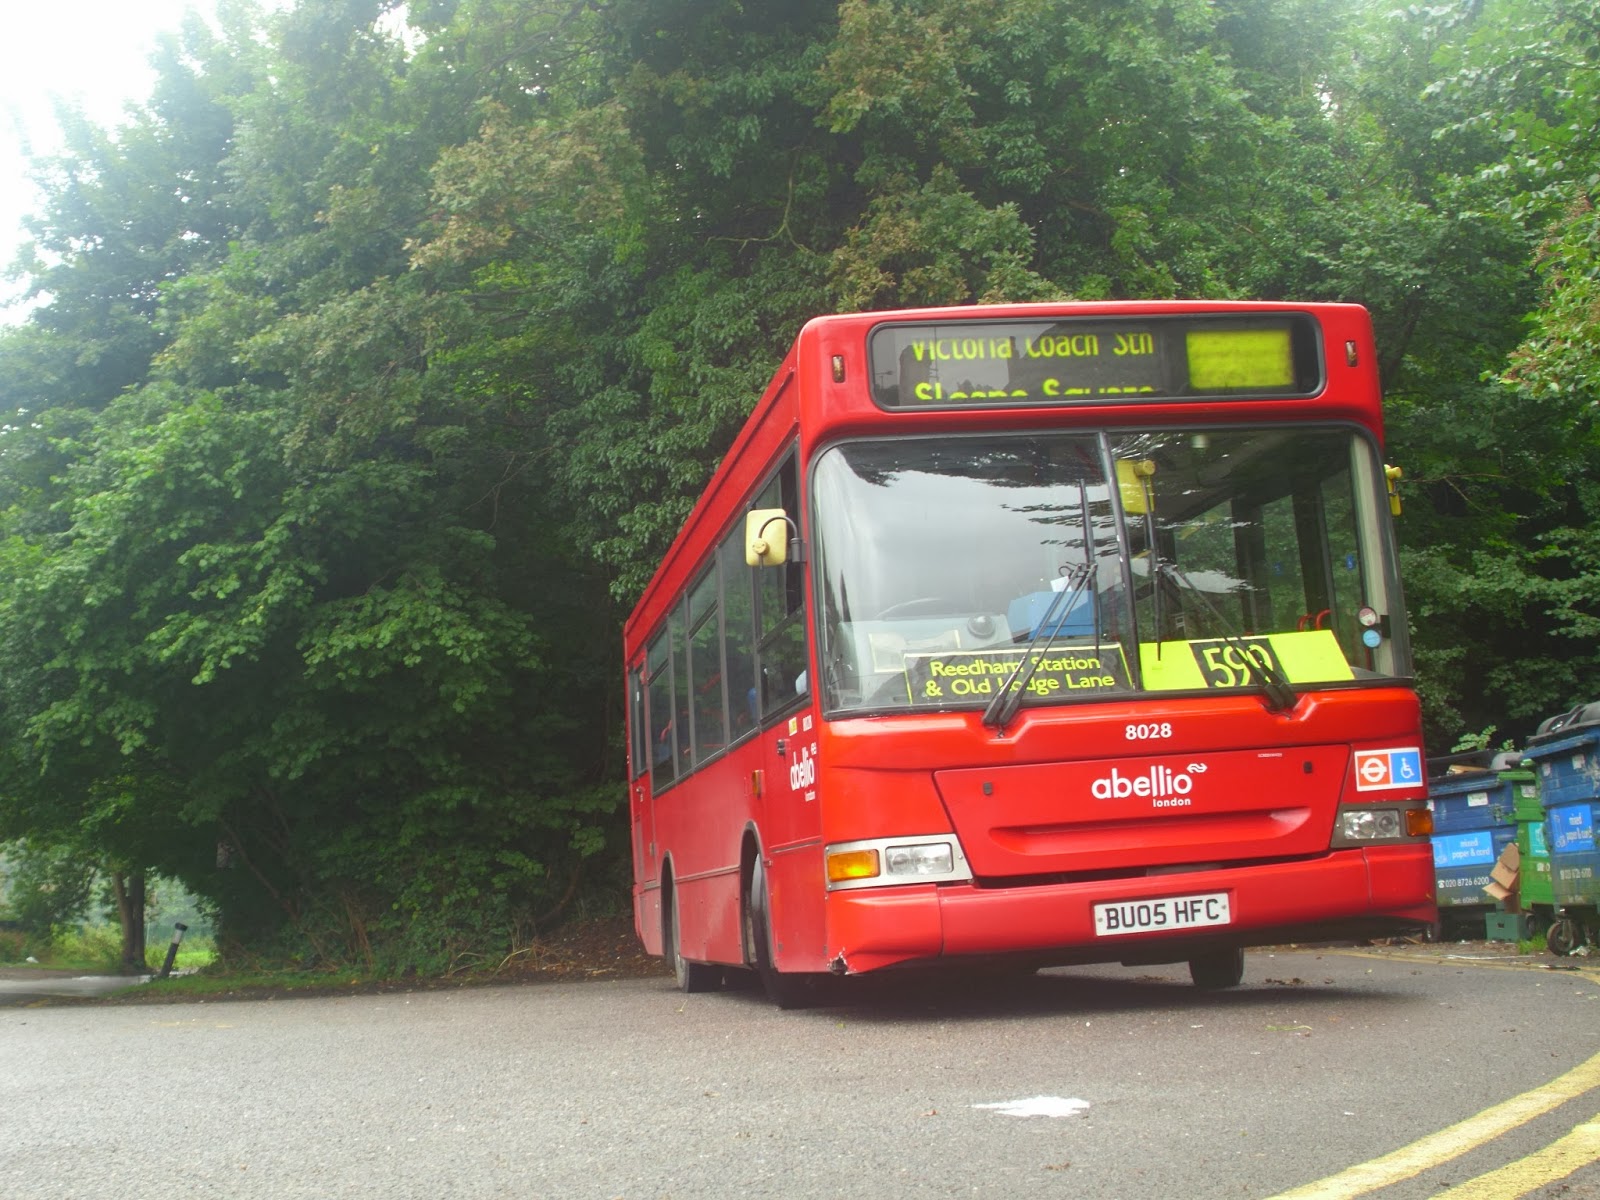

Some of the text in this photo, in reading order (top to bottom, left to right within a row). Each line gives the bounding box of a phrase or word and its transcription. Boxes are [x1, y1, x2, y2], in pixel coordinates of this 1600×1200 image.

[929, 656, 1102, 677] Reedham Station
[925, 680, 943, 697] &
[950, 678, 992, 695] Old
[1065, 673, 1116, 690] Lane
[1125, 723, 1172, 740] 8028
[1091, 765, 1193, 800] abellio
[1152, 798, 1191, 808] london
[1105, 899, 1221, 931] BU05 HFC
